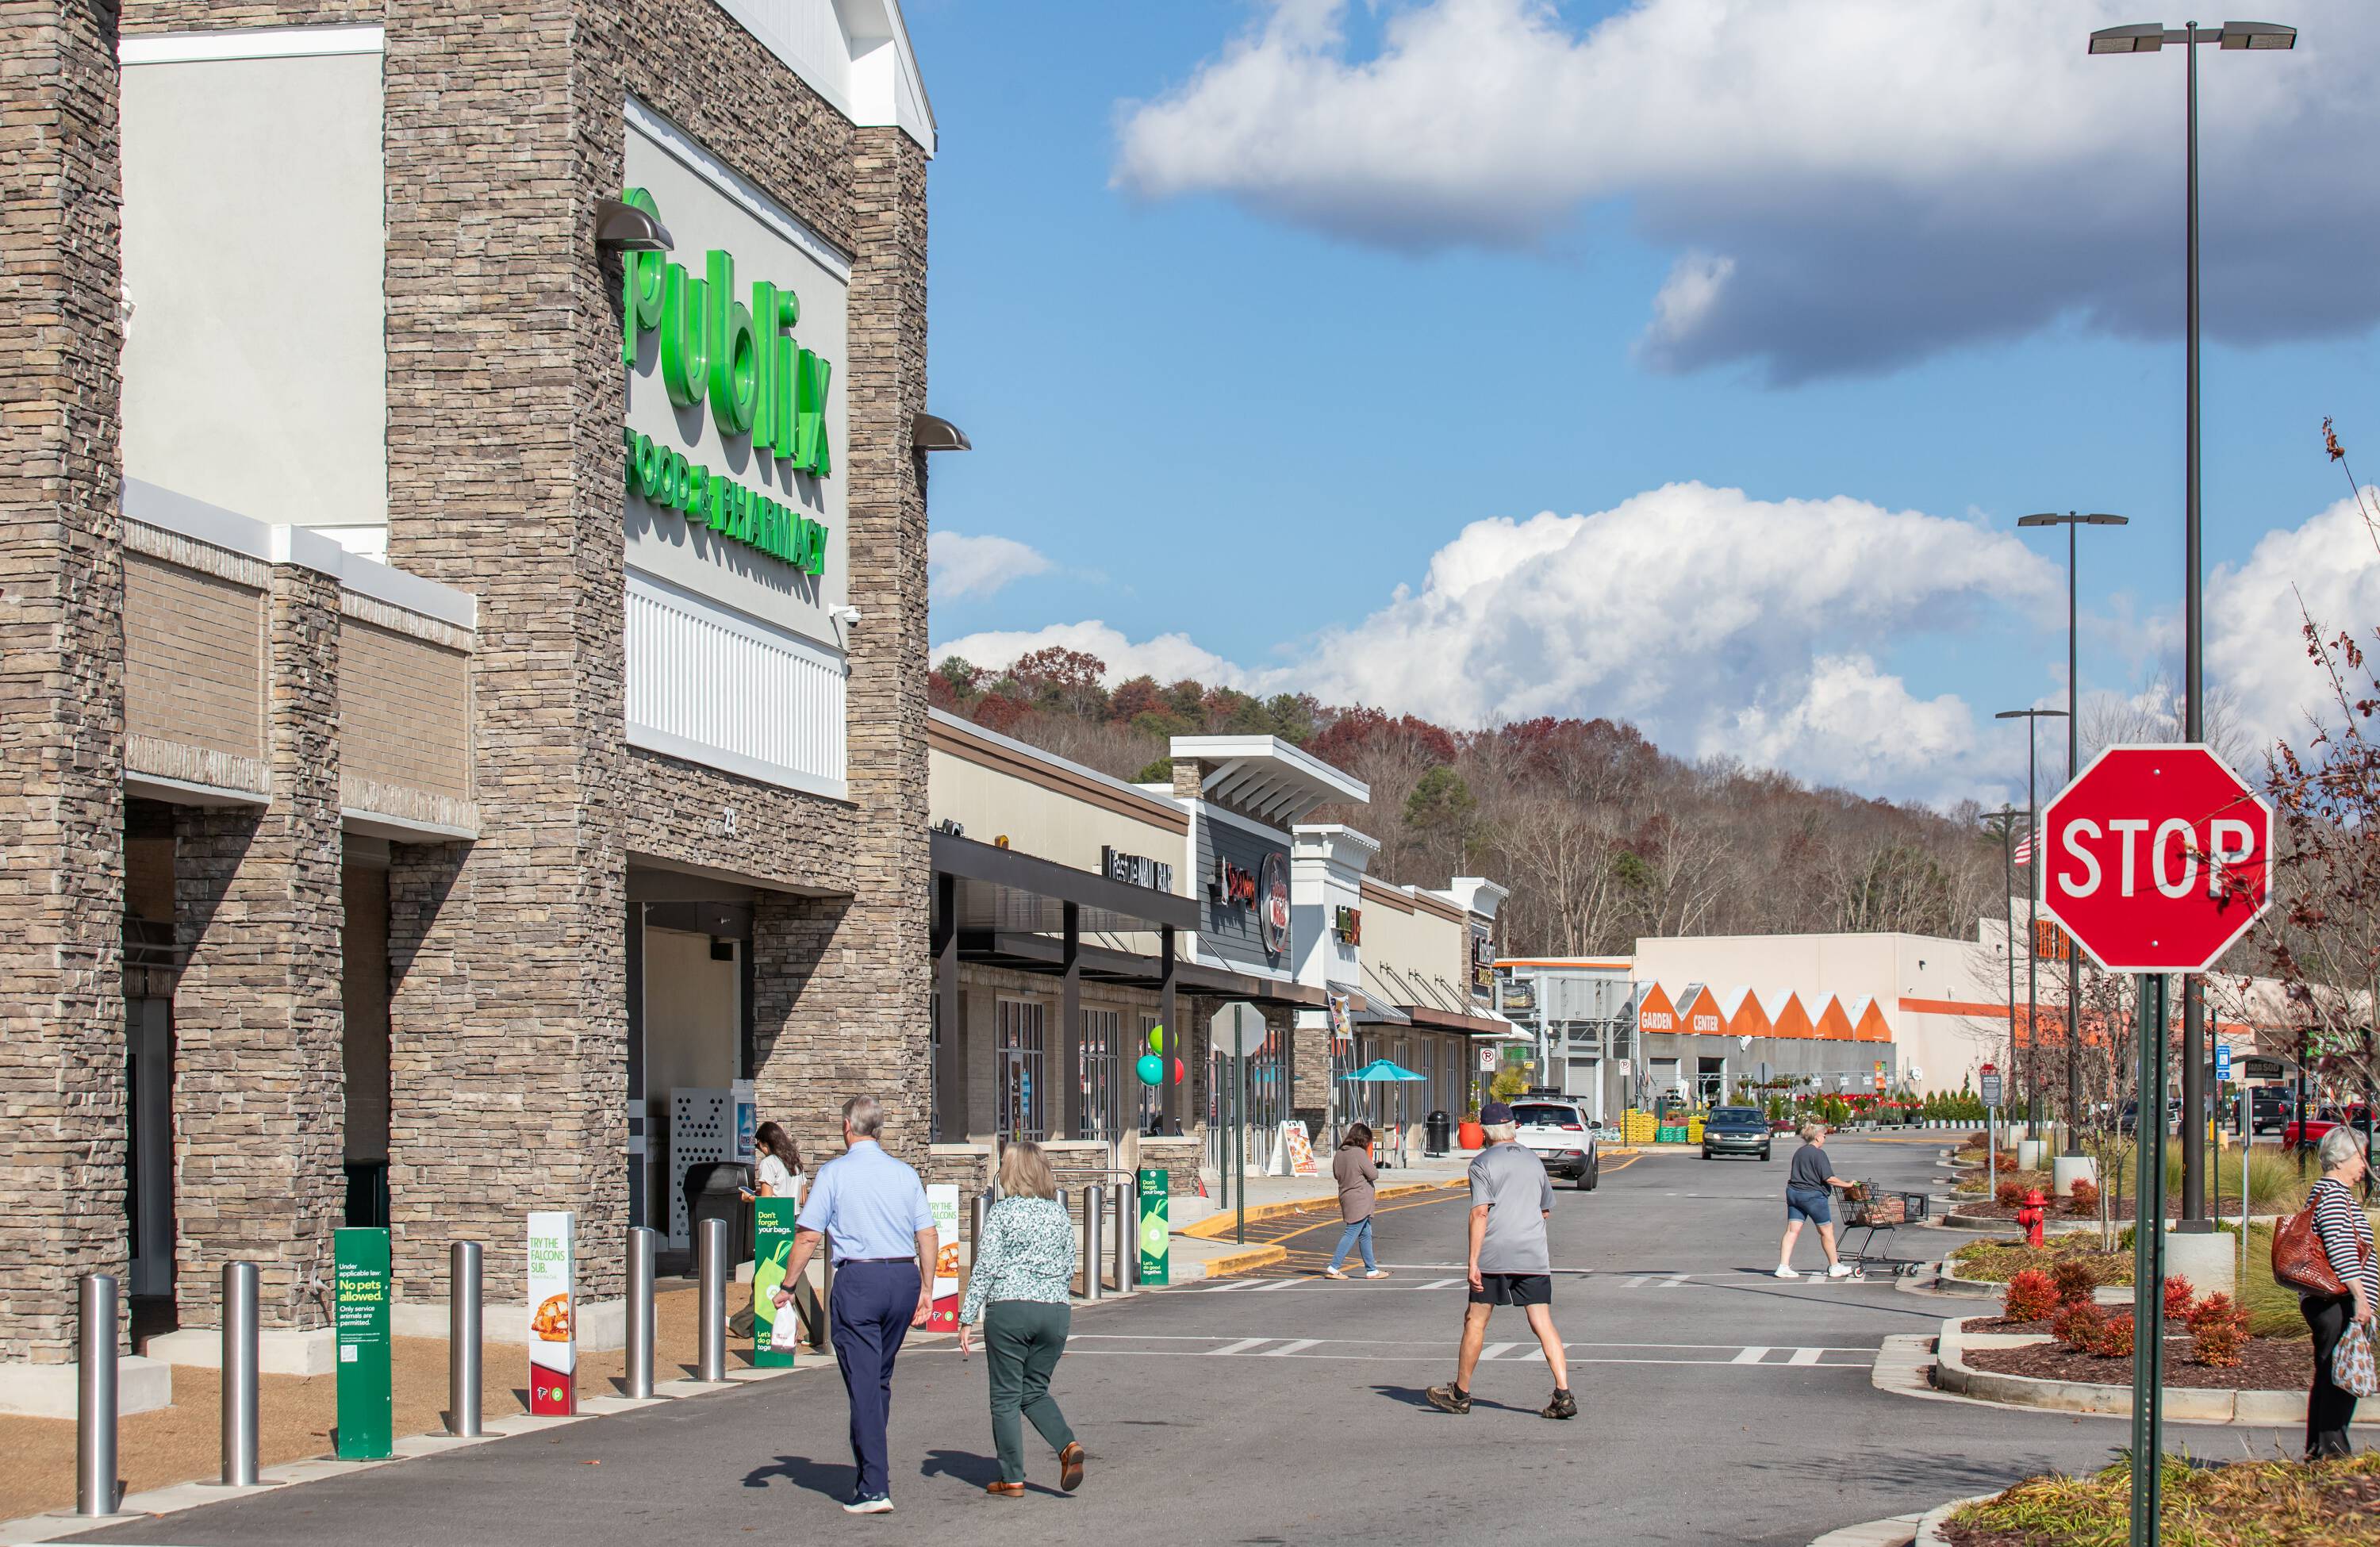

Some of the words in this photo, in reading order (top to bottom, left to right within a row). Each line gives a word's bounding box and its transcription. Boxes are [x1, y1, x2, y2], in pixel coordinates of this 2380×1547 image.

[623, 187, 831, 480] Publix
[624, 426, 690, 511] FOOD
[684, 464, 713, 524] &
[705, 475, 829, 576] PHARMACY
[2058, 818, 2255, 898] STOP
[1157, 862, 1173, 894] BAR
[1641, 1012, 1672, 1030] GARDEN
[1693, 1014, 1718, 1031] CENTER
[931, 1211, 957, 1219] ALCONS
[758, 1219, 779, 1227] forget
[774, 1226, 792, 1234] bags.
[529, 1237, 543, 1248] TRY
[544, 1238, 559, 1249] THE
[531, 1250, 566, 1261] FALCONS
[531, 1262, 547, 1273] SUB.
[340, 1269, 369, 1278] applicable
[340, 1280, 356, 1290] No
[357, 1280, 381, 1292] pets
[340, 1290, 383, 1301] allowed.
